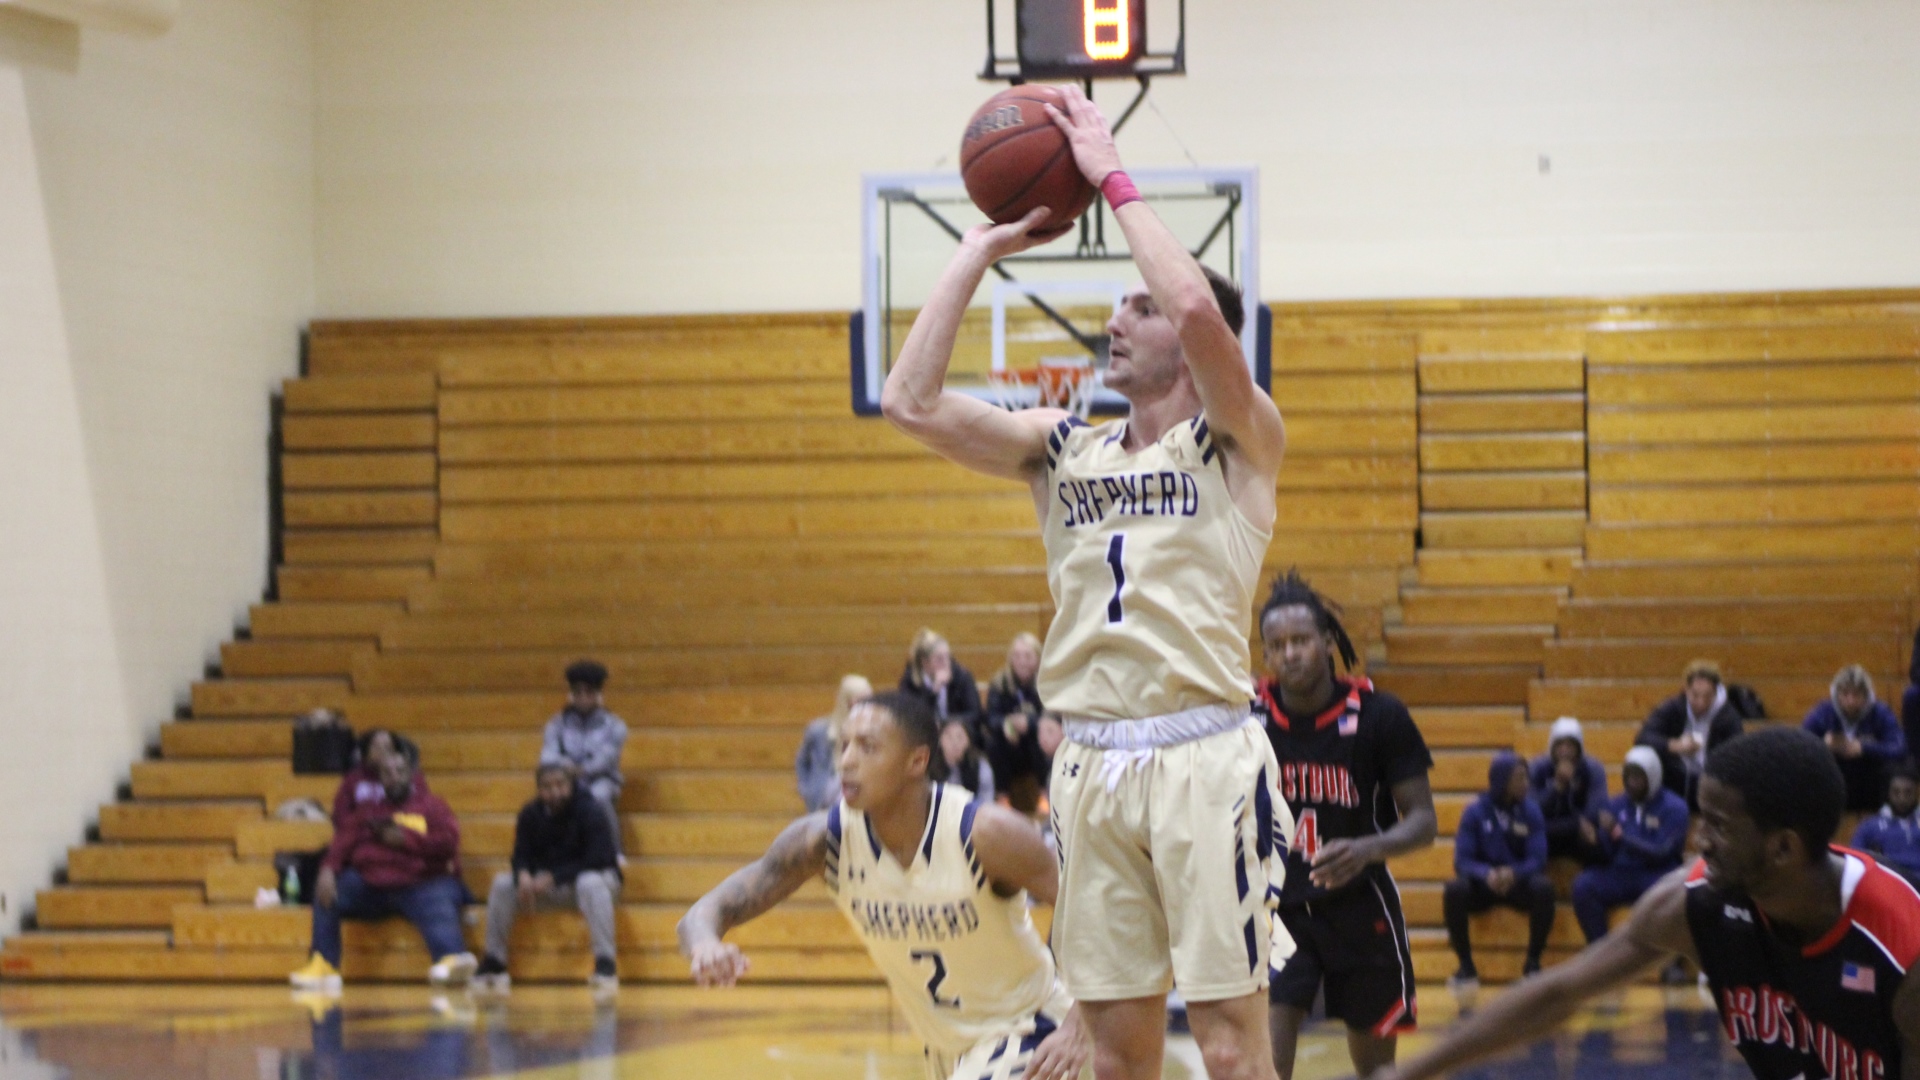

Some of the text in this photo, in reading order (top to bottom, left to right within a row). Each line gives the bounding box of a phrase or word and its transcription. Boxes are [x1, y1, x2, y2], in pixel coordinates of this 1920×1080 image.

[1083, 0, 1130, 60] 8
[1058, 472, 1199, 528] SHEPHERD
[1107, 533, 1125, 624] 1
[852, 899, 980, 942] SHEPHERD
[909, 949, 961, 1009] 2
